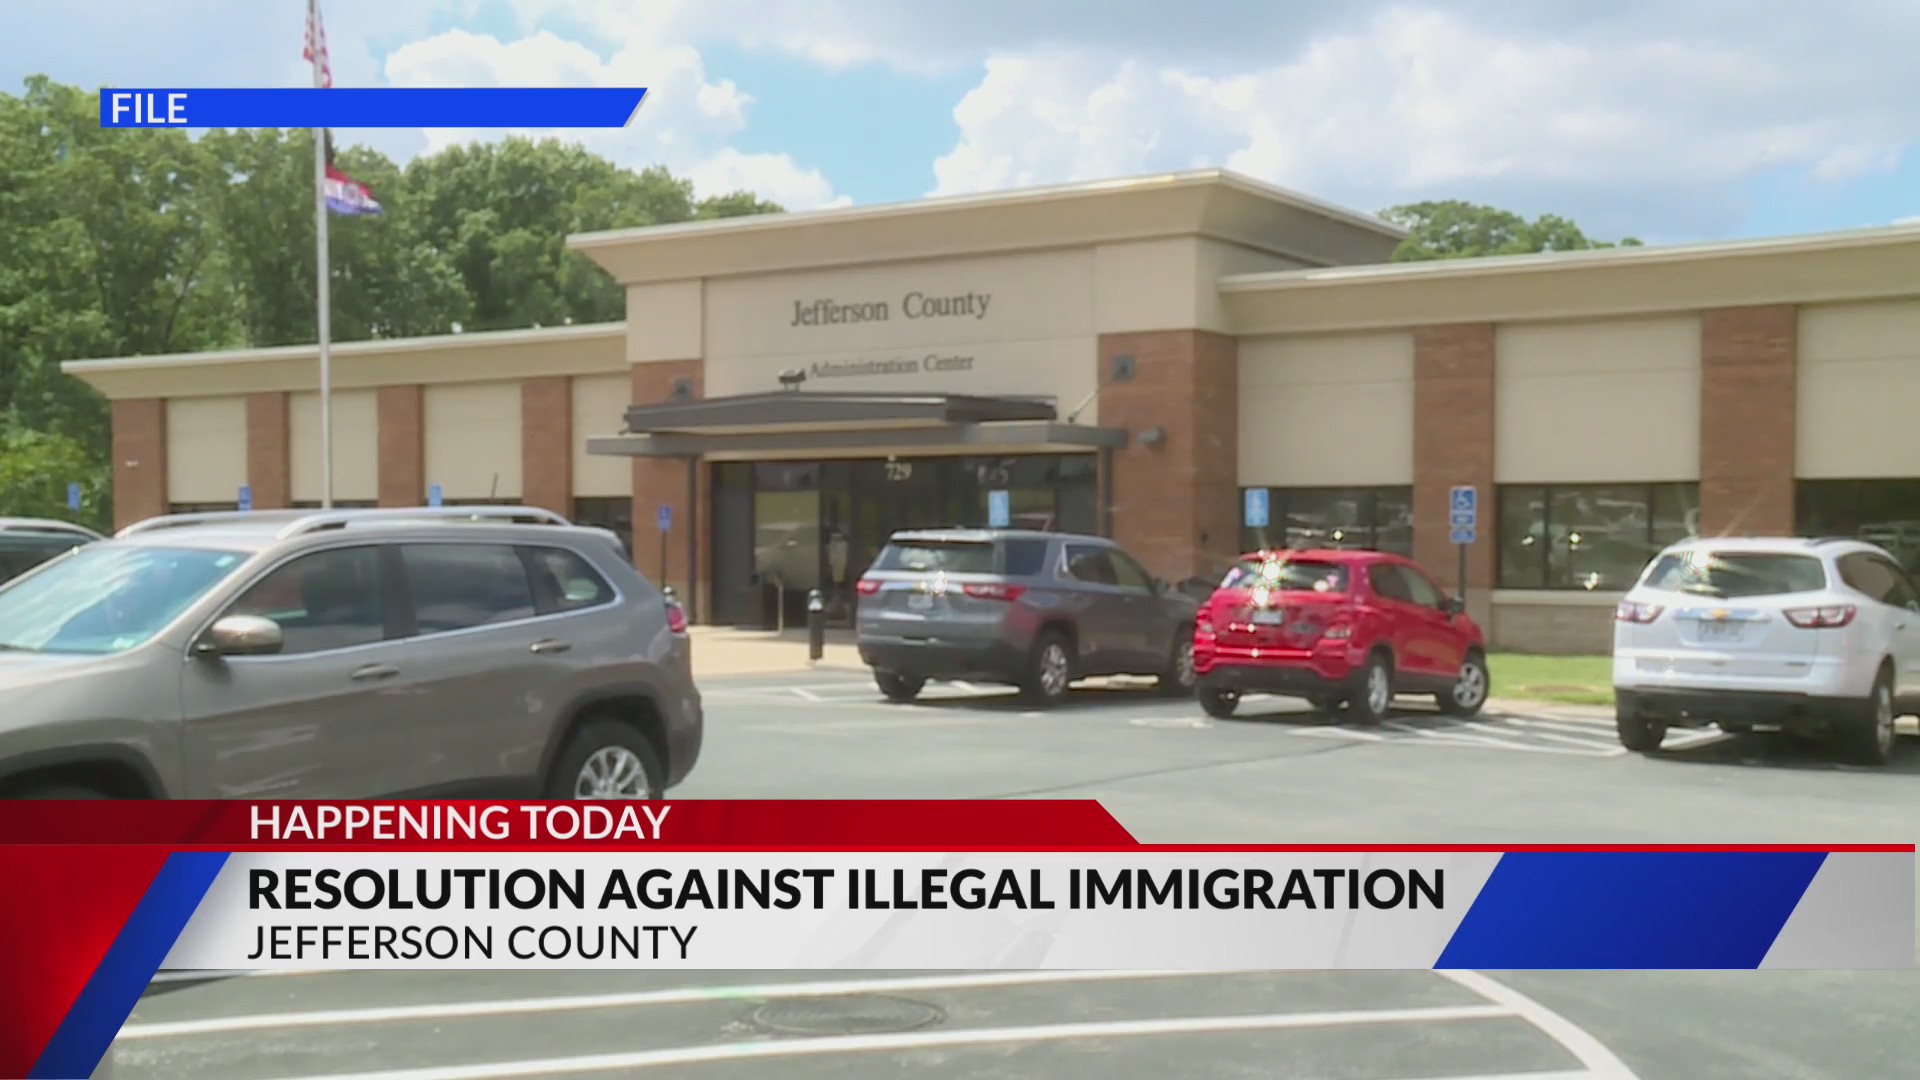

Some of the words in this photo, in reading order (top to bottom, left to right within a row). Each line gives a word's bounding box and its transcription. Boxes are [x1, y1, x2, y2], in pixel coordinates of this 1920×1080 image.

[790, 298, 889, 327] Jefferson
[902, 291, 991, 320] County
[923, 353, 974, 373] Center
[885, 462, 912, 481] 729
